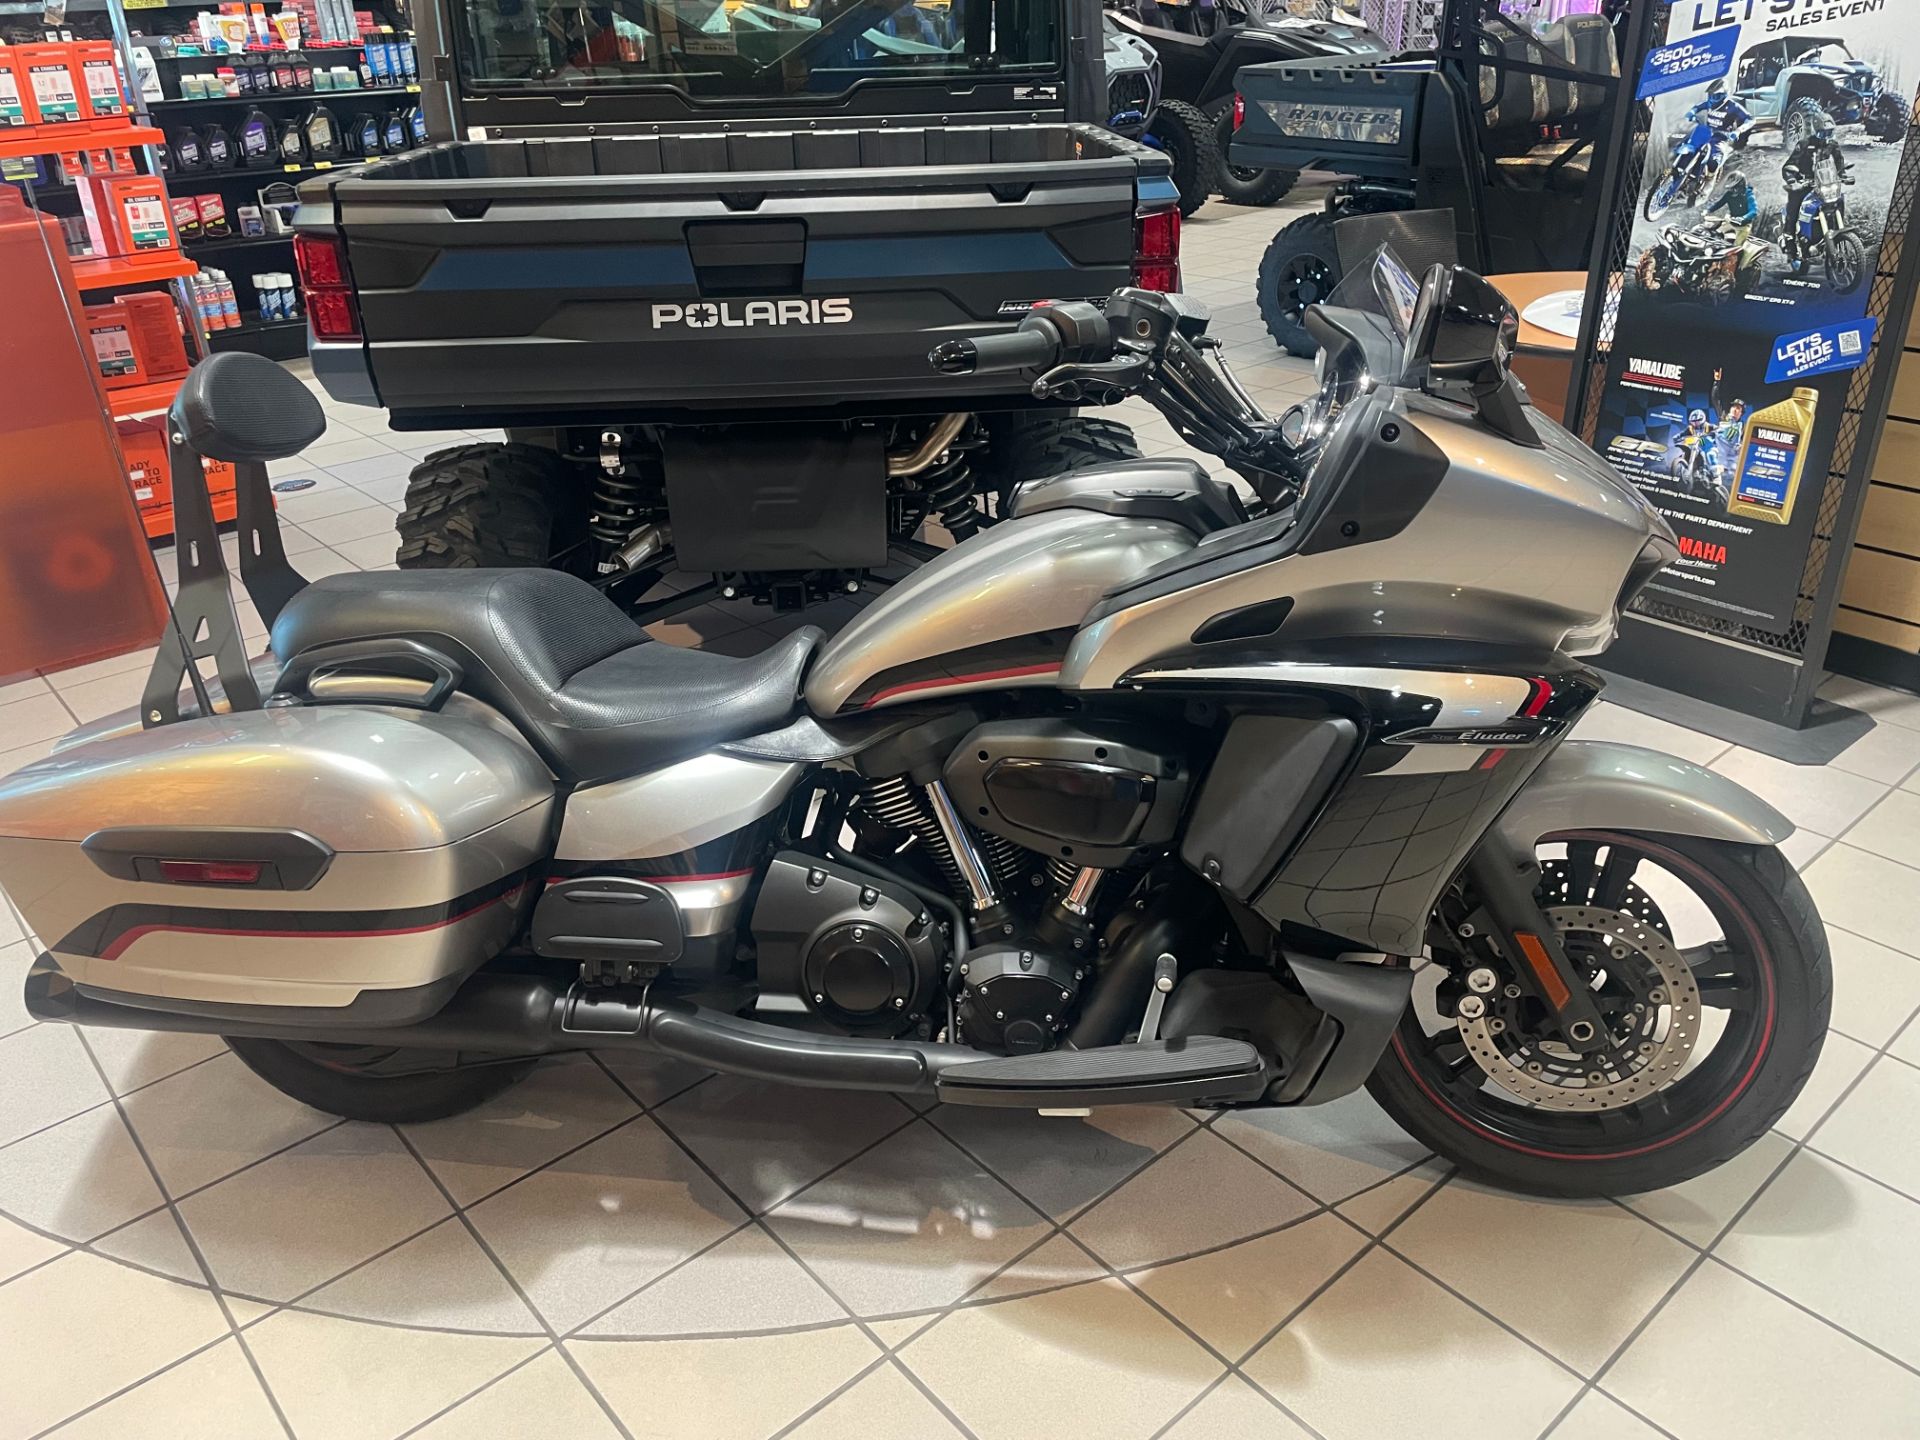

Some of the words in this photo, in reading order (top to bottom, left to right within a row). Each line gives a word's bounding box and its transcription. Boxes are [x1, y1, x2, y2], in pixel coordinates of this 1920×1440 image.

[1693, 0, 1795, 31] LET
[1766, 10, 1822, 32] SALES
[1826, 0, 1885, 21] EVENT
[1288, 110, 1390, 124] RANGER
[652, 298, 853, 328] POLARIS
[1776, 332, 1822, 360] LET'S
[1794, 340, 1834, 366] RIDE
[1629, 358, 1682, 380] YAMALUBE
[1786, 364, 1809, 376] SALES
[1809, 354, 1831, 368] EVENT
[1758, 428, 1794, 444] YAMALUBE
[130, 460, 150, 472] ADY
[1622, 458, 1644, 466] Approved
[1624, 465, 1640, 474] Quality
[148, 468, 160, 476] TO
[1626, 473, 1642, 481] Engine
[134, 476, 162, 489] RACE
[1660, 488, 1678, 498] Shifting
[1678, 492, 1710, 504] Performance
[1672, 511, 1685, 520] THE
[1685, 514, 1707, 525] PARTS
[1707, 519, 1753, 535] DEPARTMENT
[1679, 536, 1727, 564] MAHA
[1660, 567, 1716, 586] aMotorsports.com
[1458, 730, 1528, 740] Eluder
